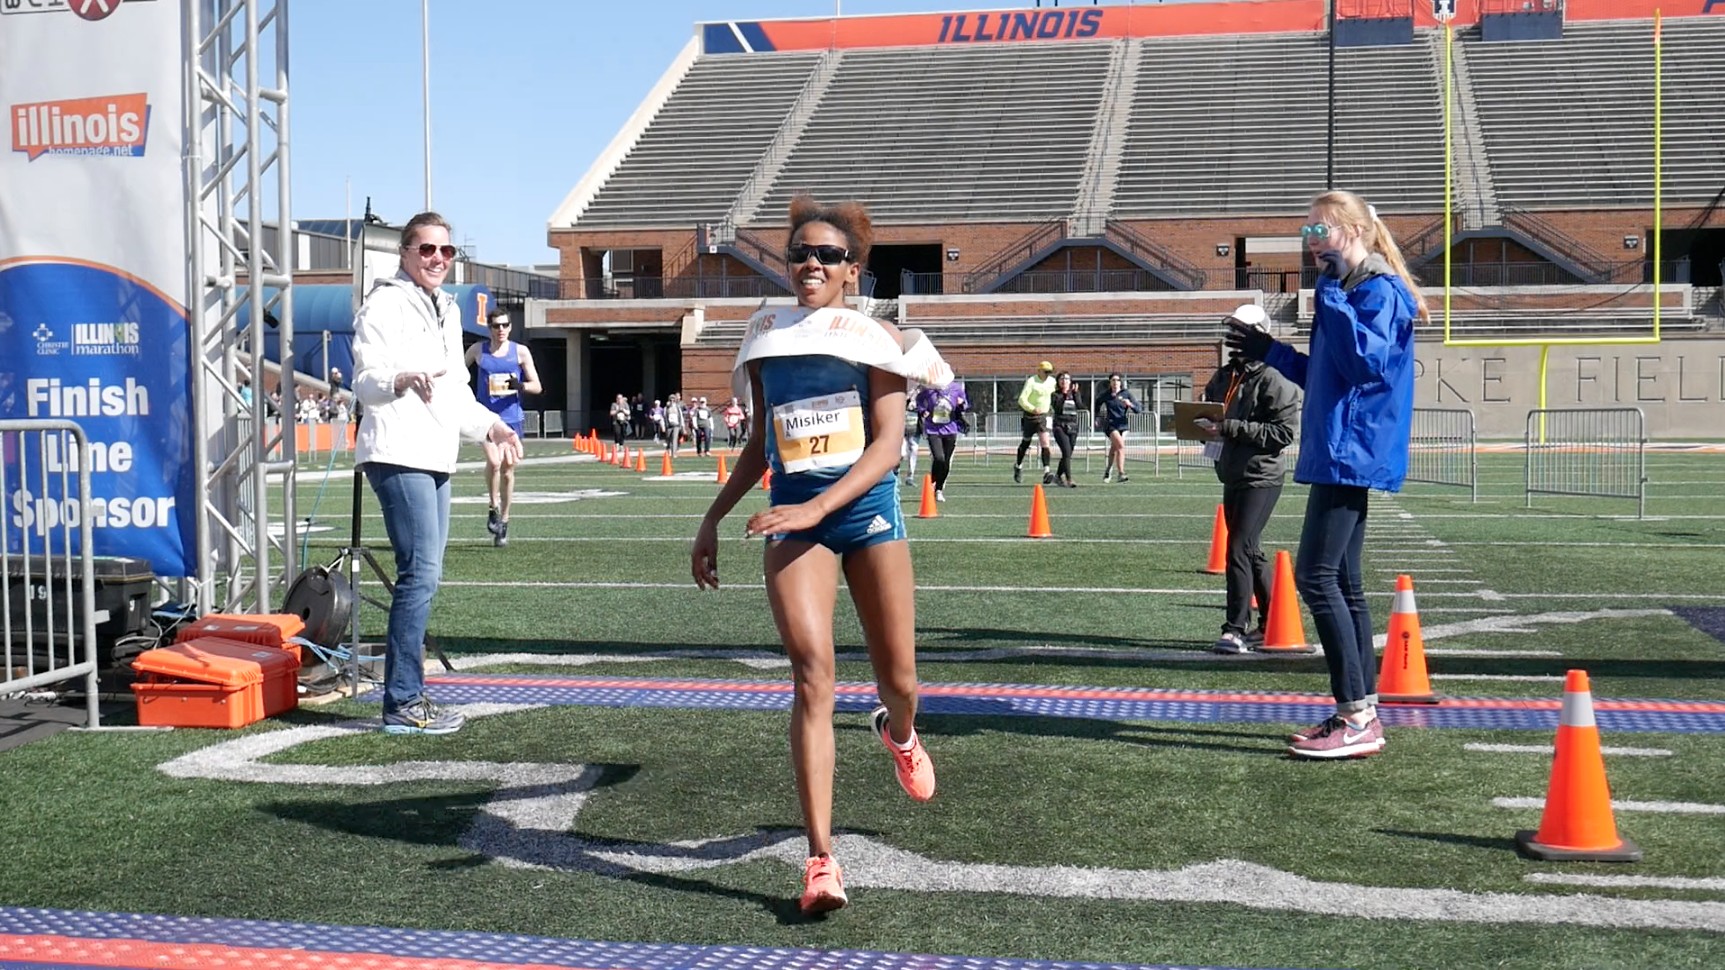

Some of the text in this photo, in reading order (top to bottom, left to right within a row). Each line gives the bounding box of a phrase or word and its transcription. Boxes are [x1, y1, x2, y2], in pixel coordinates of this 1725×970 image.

[938, 10, 1103, 42] ILLINOIS
[18, 104, 140, 146] illinois
[76, 342, 139, 355] marathon
[27, 377, 149, 417] Finish
[1576, 356, 1725, 403] FIEL
[785, 411, 841, 431] Misiker
[47, 433, 133, 472] Line
[809, 435, 830, 455] 27
[13, 489, 175, 537] Sponsor
